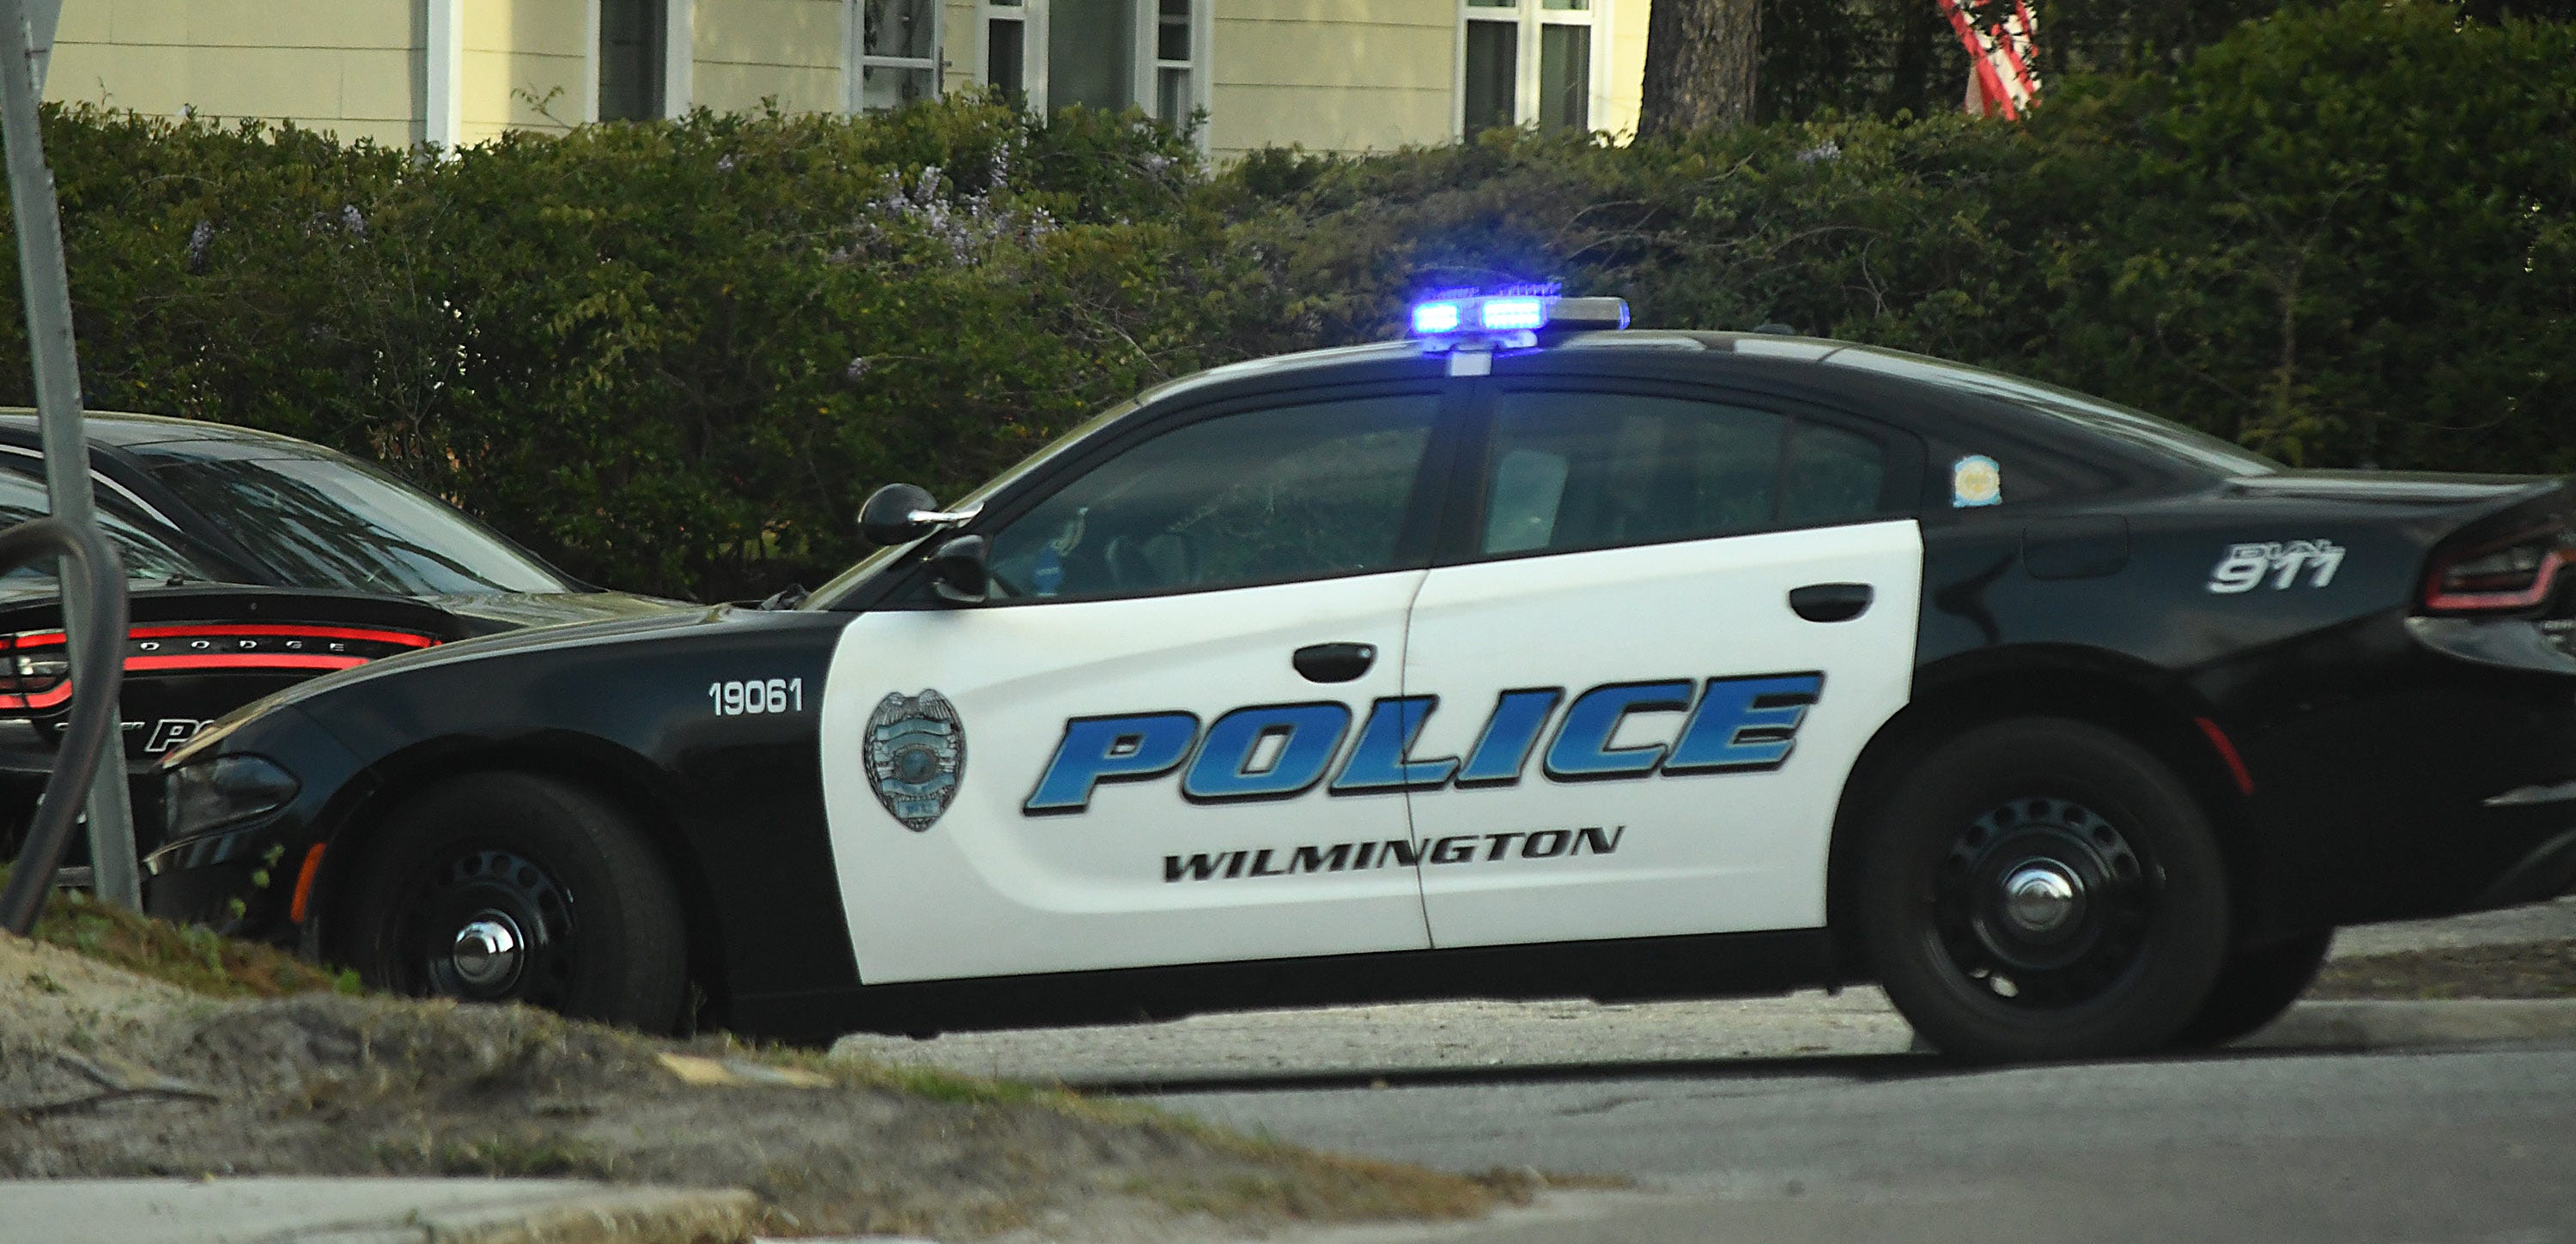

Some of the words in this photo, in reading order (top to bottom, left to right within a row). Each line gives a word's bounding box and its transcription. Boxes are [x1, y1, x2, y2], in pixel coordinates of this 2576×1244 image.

[2208, 552, 2346, 593] 911
[140, 640, 345, 652] DODGE
[708, 677, 804, 716] 19061
[1023, 670, 1826, 816] POLICE
[1162, 824, 1625, 883] WILMINGTON
